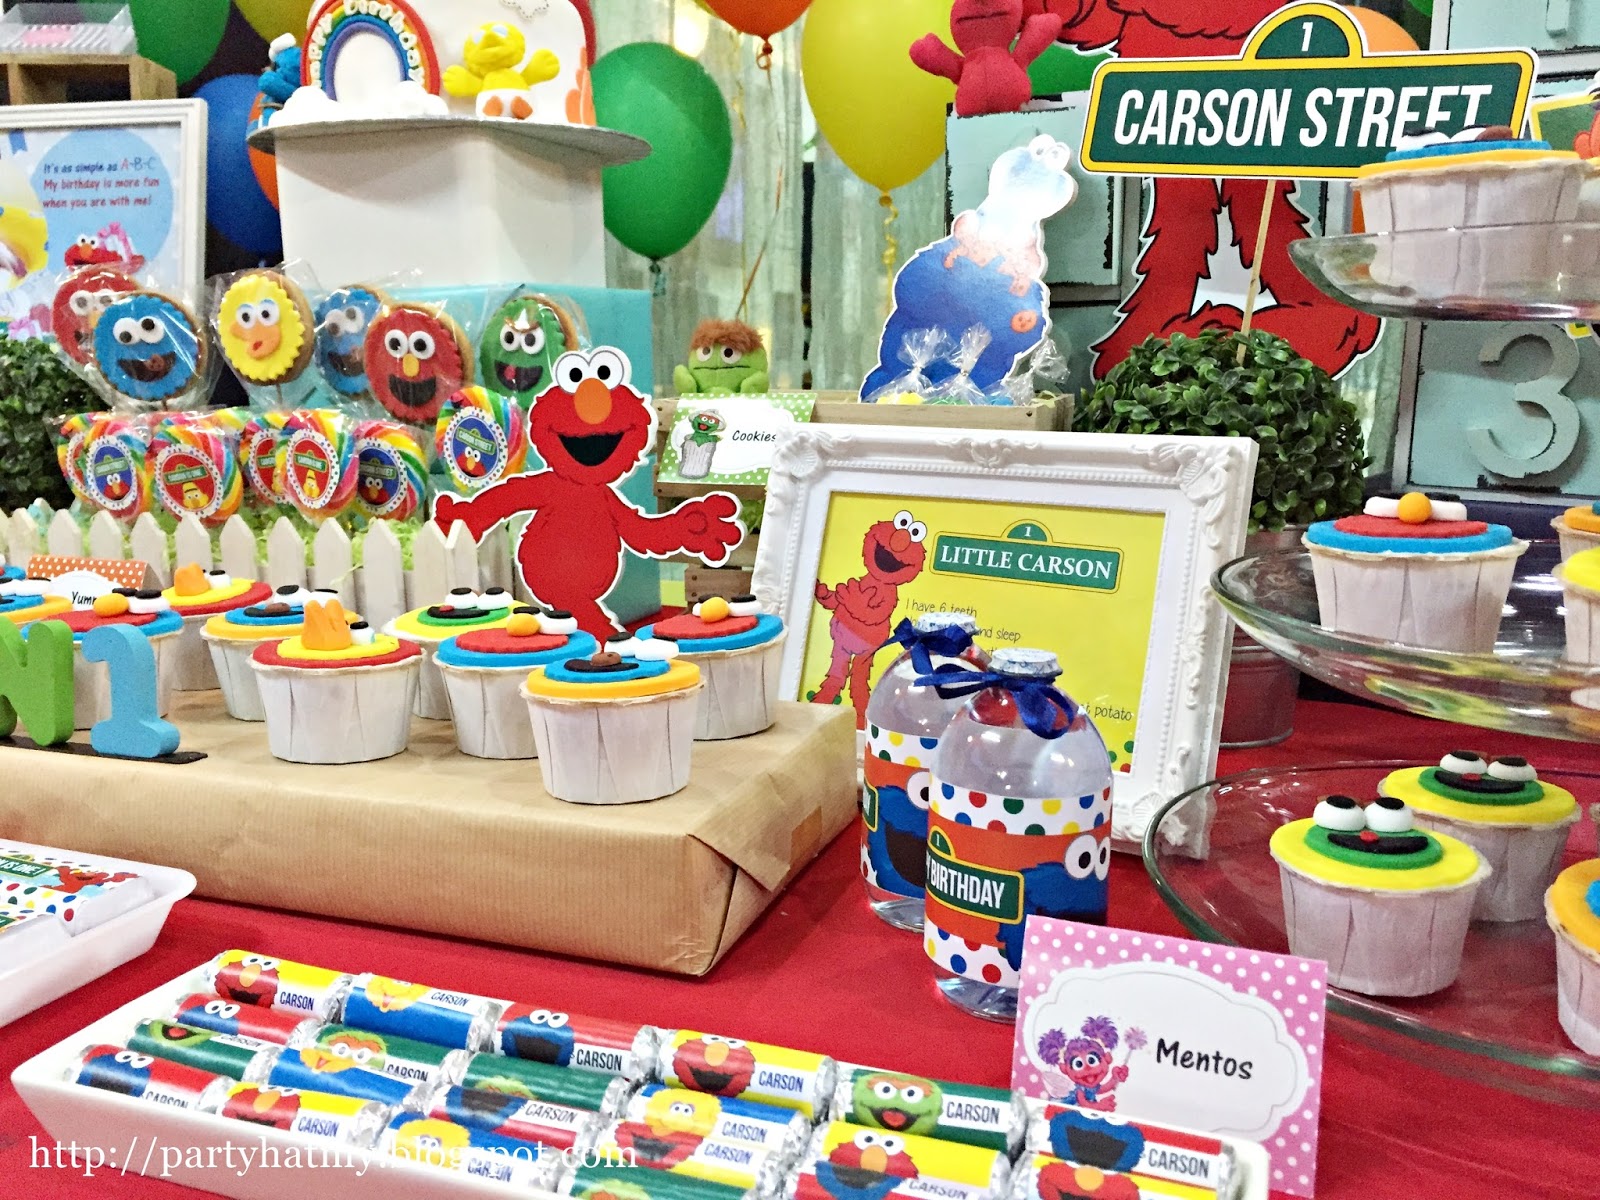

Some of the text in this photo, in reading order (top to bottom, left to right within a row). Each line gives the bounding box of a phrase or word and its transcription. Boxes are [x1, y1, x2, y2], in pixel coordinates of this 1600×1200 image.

[1300, 22, 1313, 52] 1
[1113, 85, 1493, 148] CARSON STREET
[43, 179, 57, 192] My
[61, 179, 100, 190] birthday
[115, 179, 140, 188] more
[143, 177, 160, 187] fun
[43, 198, 67, 208] when
[71, 199, 87, 210] you
[90, 199, 105, 207] are
[109, 196, 131, 206] with
[1023, 526, 1032, 537] 1
[940, 545, 1112, 580] LITTLE CARSON
[912, 599, 936, 613] have
[939, 602, 946, 613] 6
[996, 628, 1021, 643] sleep
[81, 623, 181, 759] 1
[1094, 705, 1132, 721] potato
[930, 858, 1005, 910] BIRTHDAY
[279, 991, 315, 1011] CARSON
[430, 991, 470, 1007] CARSON
[576, 1049, 623, 1071] CARSON
[1156, 1038, 1253, 1080] Mentos
[758, 1070, 804, 1093] CARSON
[525, 1103, 578, 1124] CARSON
[946, 1101, 1000, 1124] CARSON
[297, 1116, 340, 1138] CARSON
[721, 1121, 768, 1143] CARSON
[704, 1143, 753, 1165] CARSON
[1148, 1148, 1210, 1178] CARSON
